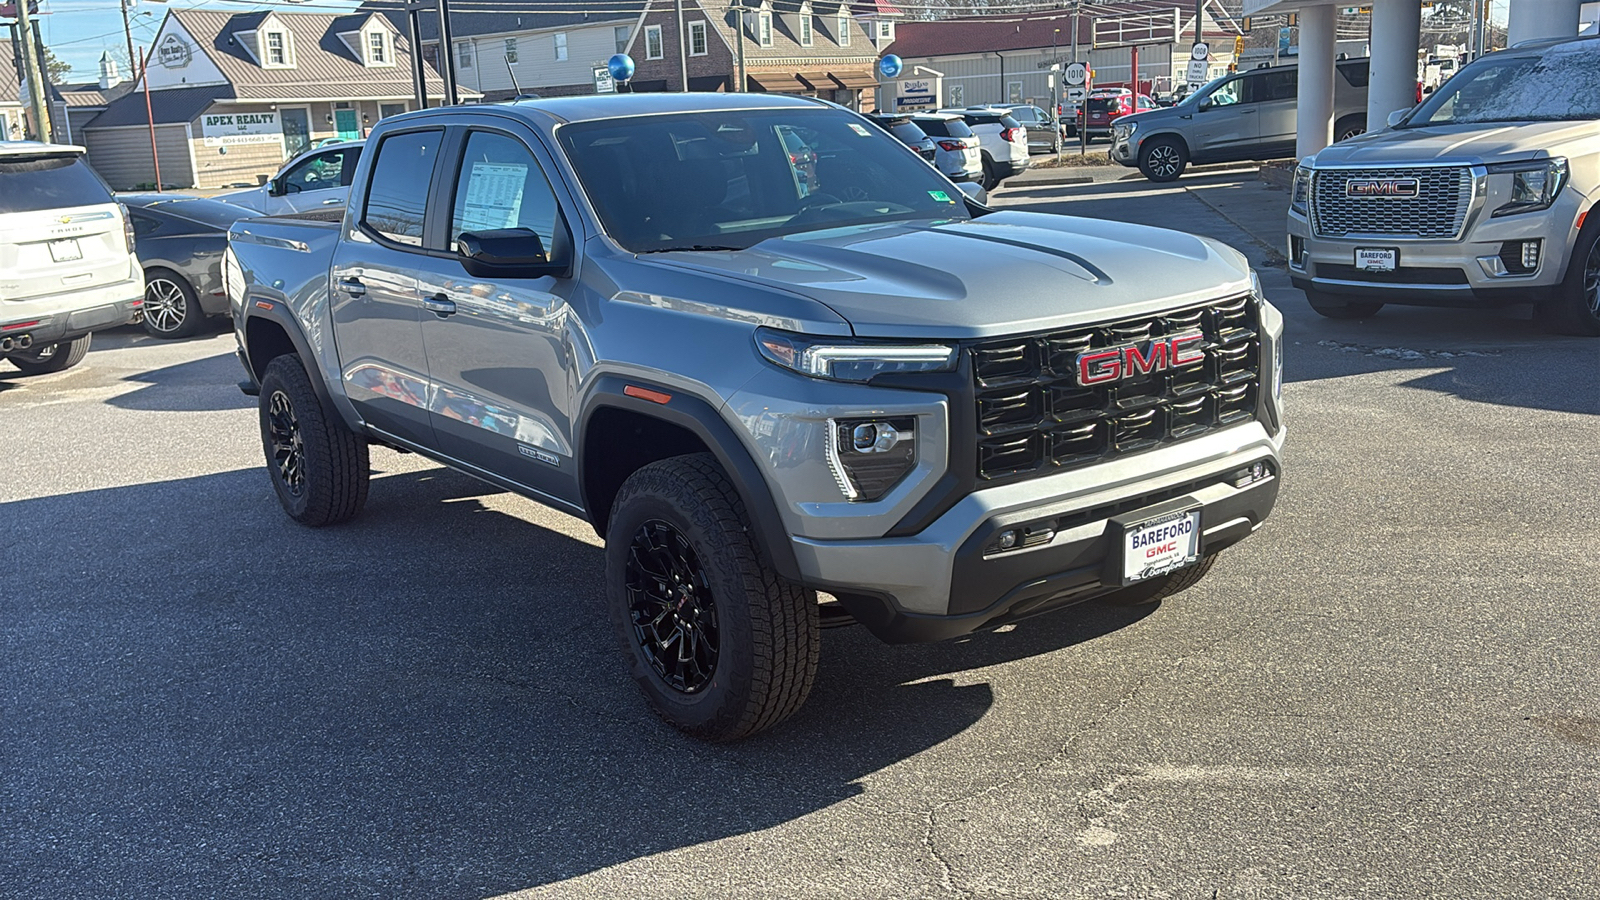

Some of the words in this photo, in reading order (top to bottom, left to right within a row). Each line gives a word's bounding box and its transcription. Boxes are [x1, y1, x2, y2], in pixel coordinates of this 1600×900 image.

[1068, 69, 1084, 79] 1010
[206, 115, 234, 126] APEX
[236, 114, 275, 125] REALTY
[1348, 180, 1416, 195] GMC
[51, 226, 84, 234] TAHOE
[1360, 252, 1393, 260] BAREFORD
[1076, 330, 1206, 386] GMC
[1132, 520, 1192, 550] BAREFORD
[1146, 541, 1178, 558] GMC
